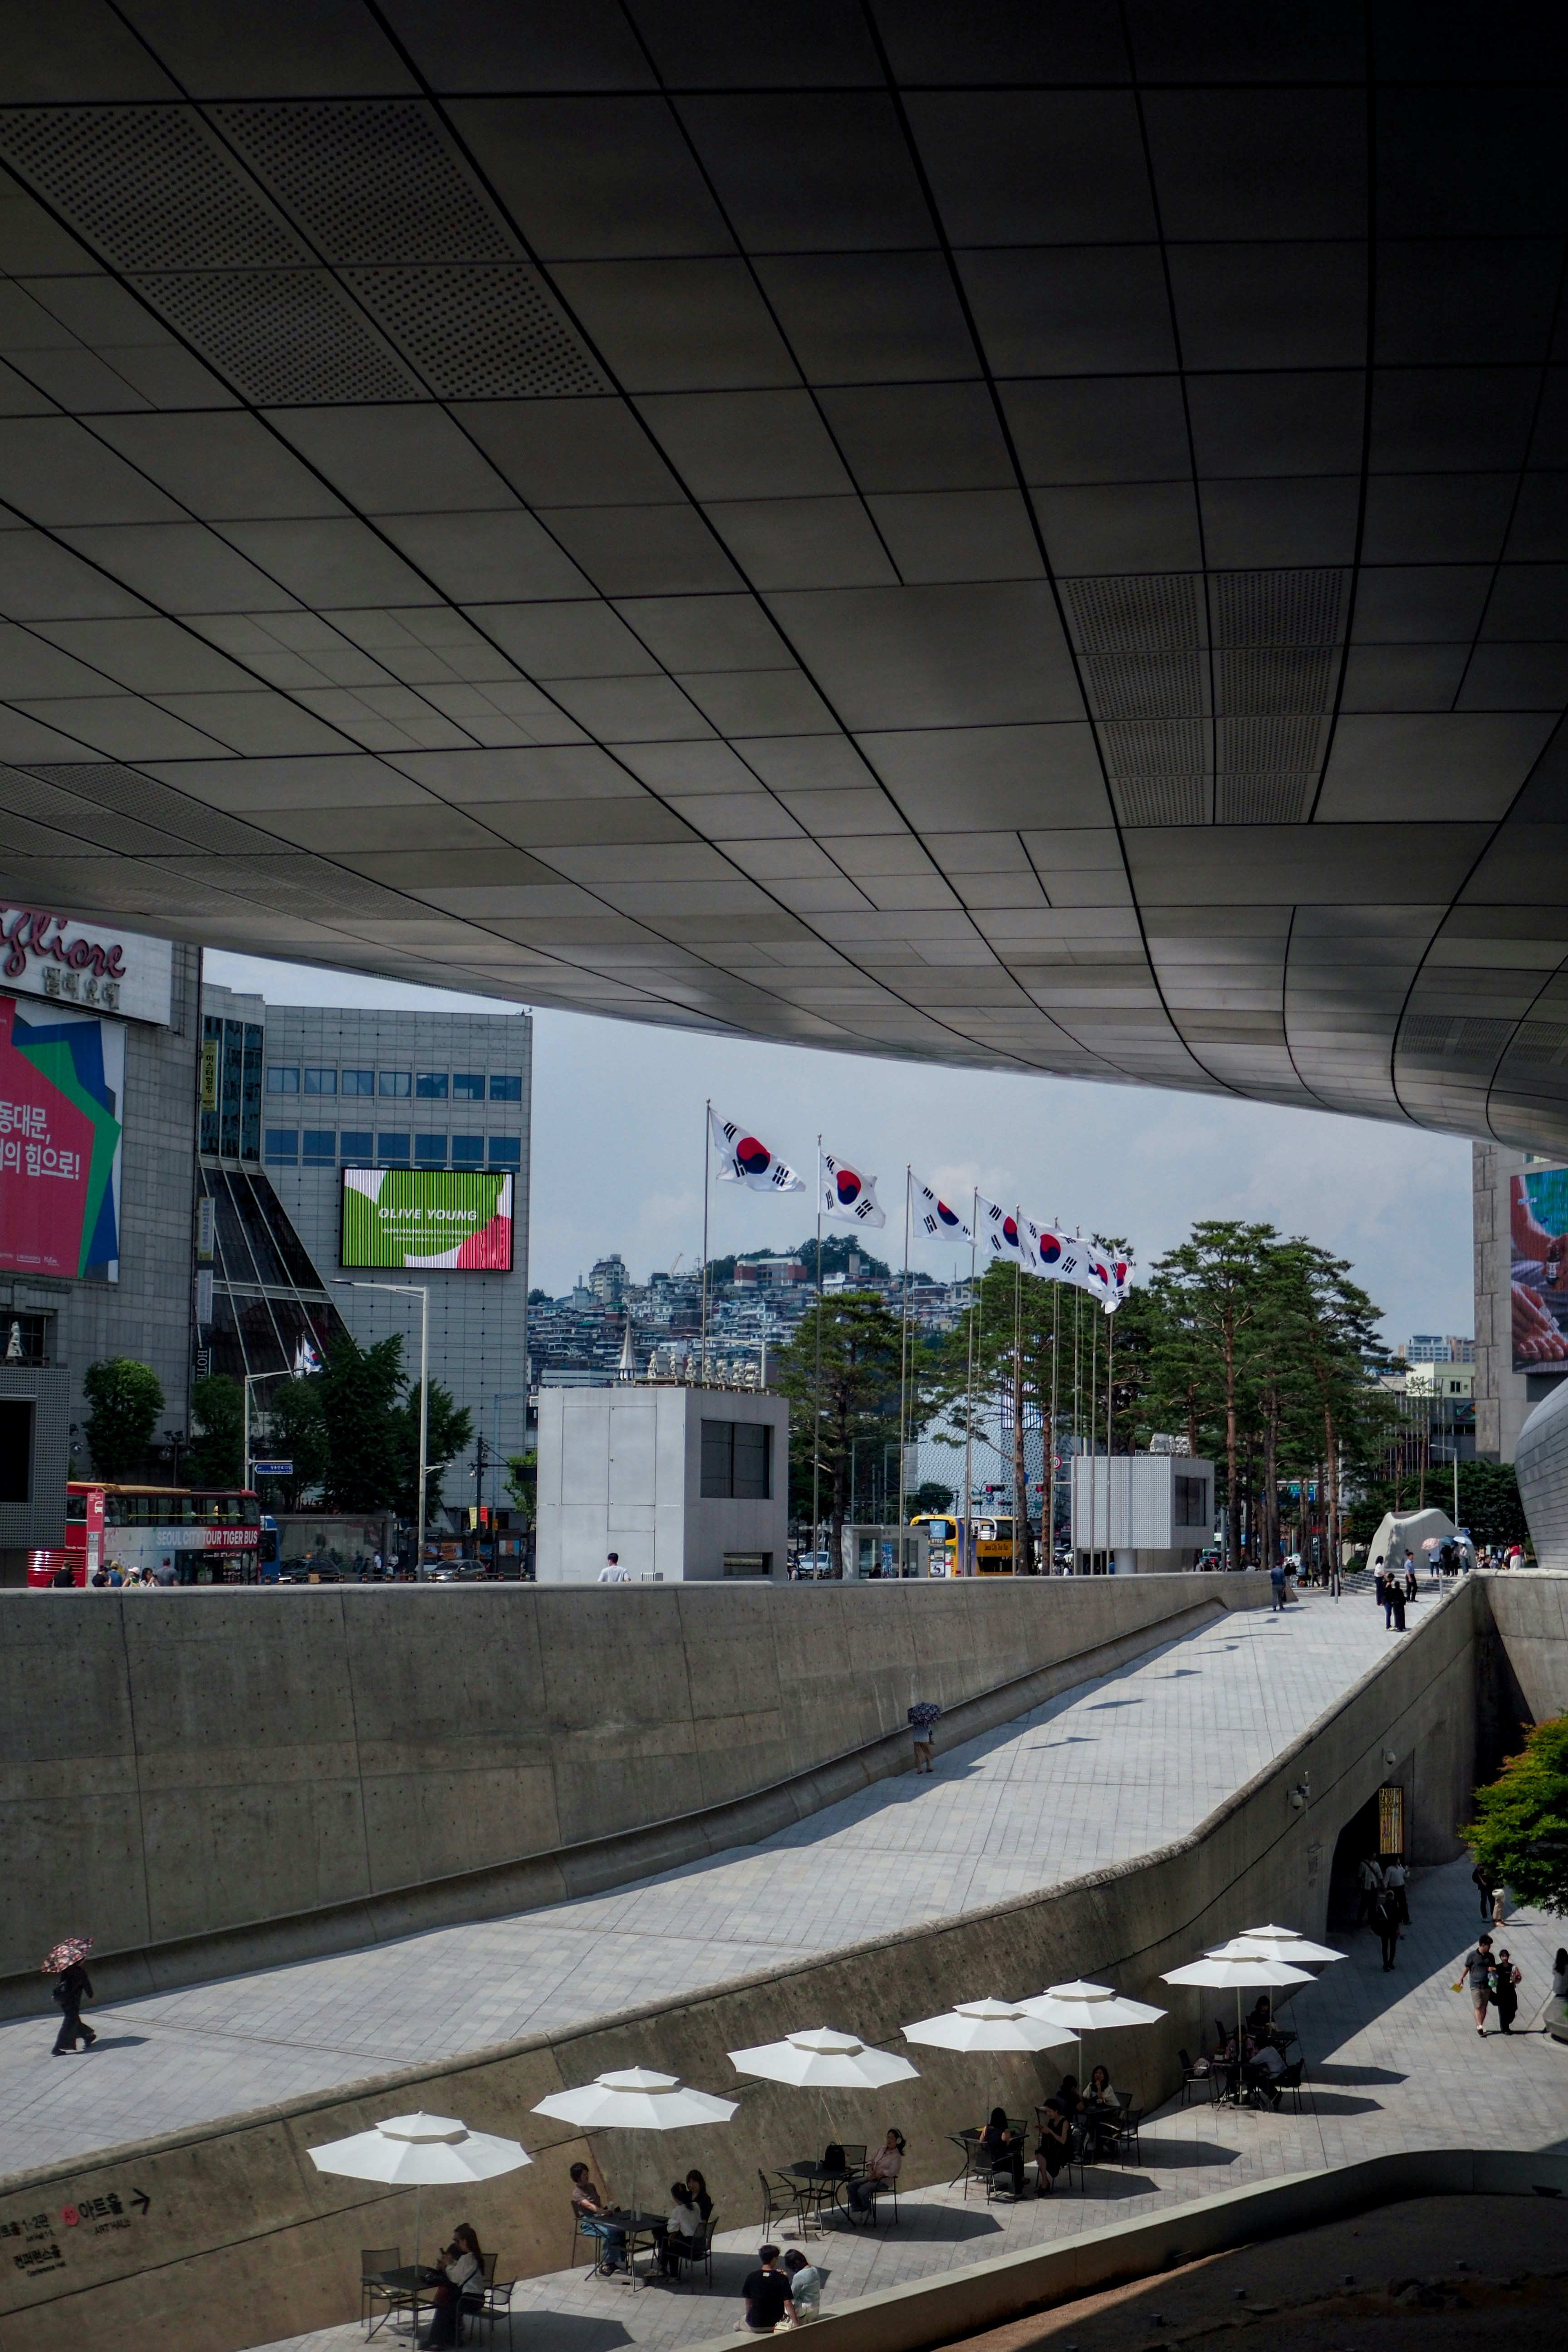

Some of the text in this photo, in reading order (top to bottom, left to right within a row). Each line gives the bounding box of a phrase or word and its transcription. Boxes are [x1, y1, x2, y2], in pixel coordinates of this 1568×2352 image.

[0, 1101, 50, 1145] 동대문,
[25, 1143, 80, 1181] 힘으로!
[379, 1207, 477, 1220] OLIVE YOUNG
[197, 1350, 208, 1380] HOTE
[157, 1530, 258, 1545] SEOUL CITY TOUR TIGER BUS
[78, 2192, 123, 2220] 아트홀
[0, 2221, 21, 2239] 트홀
